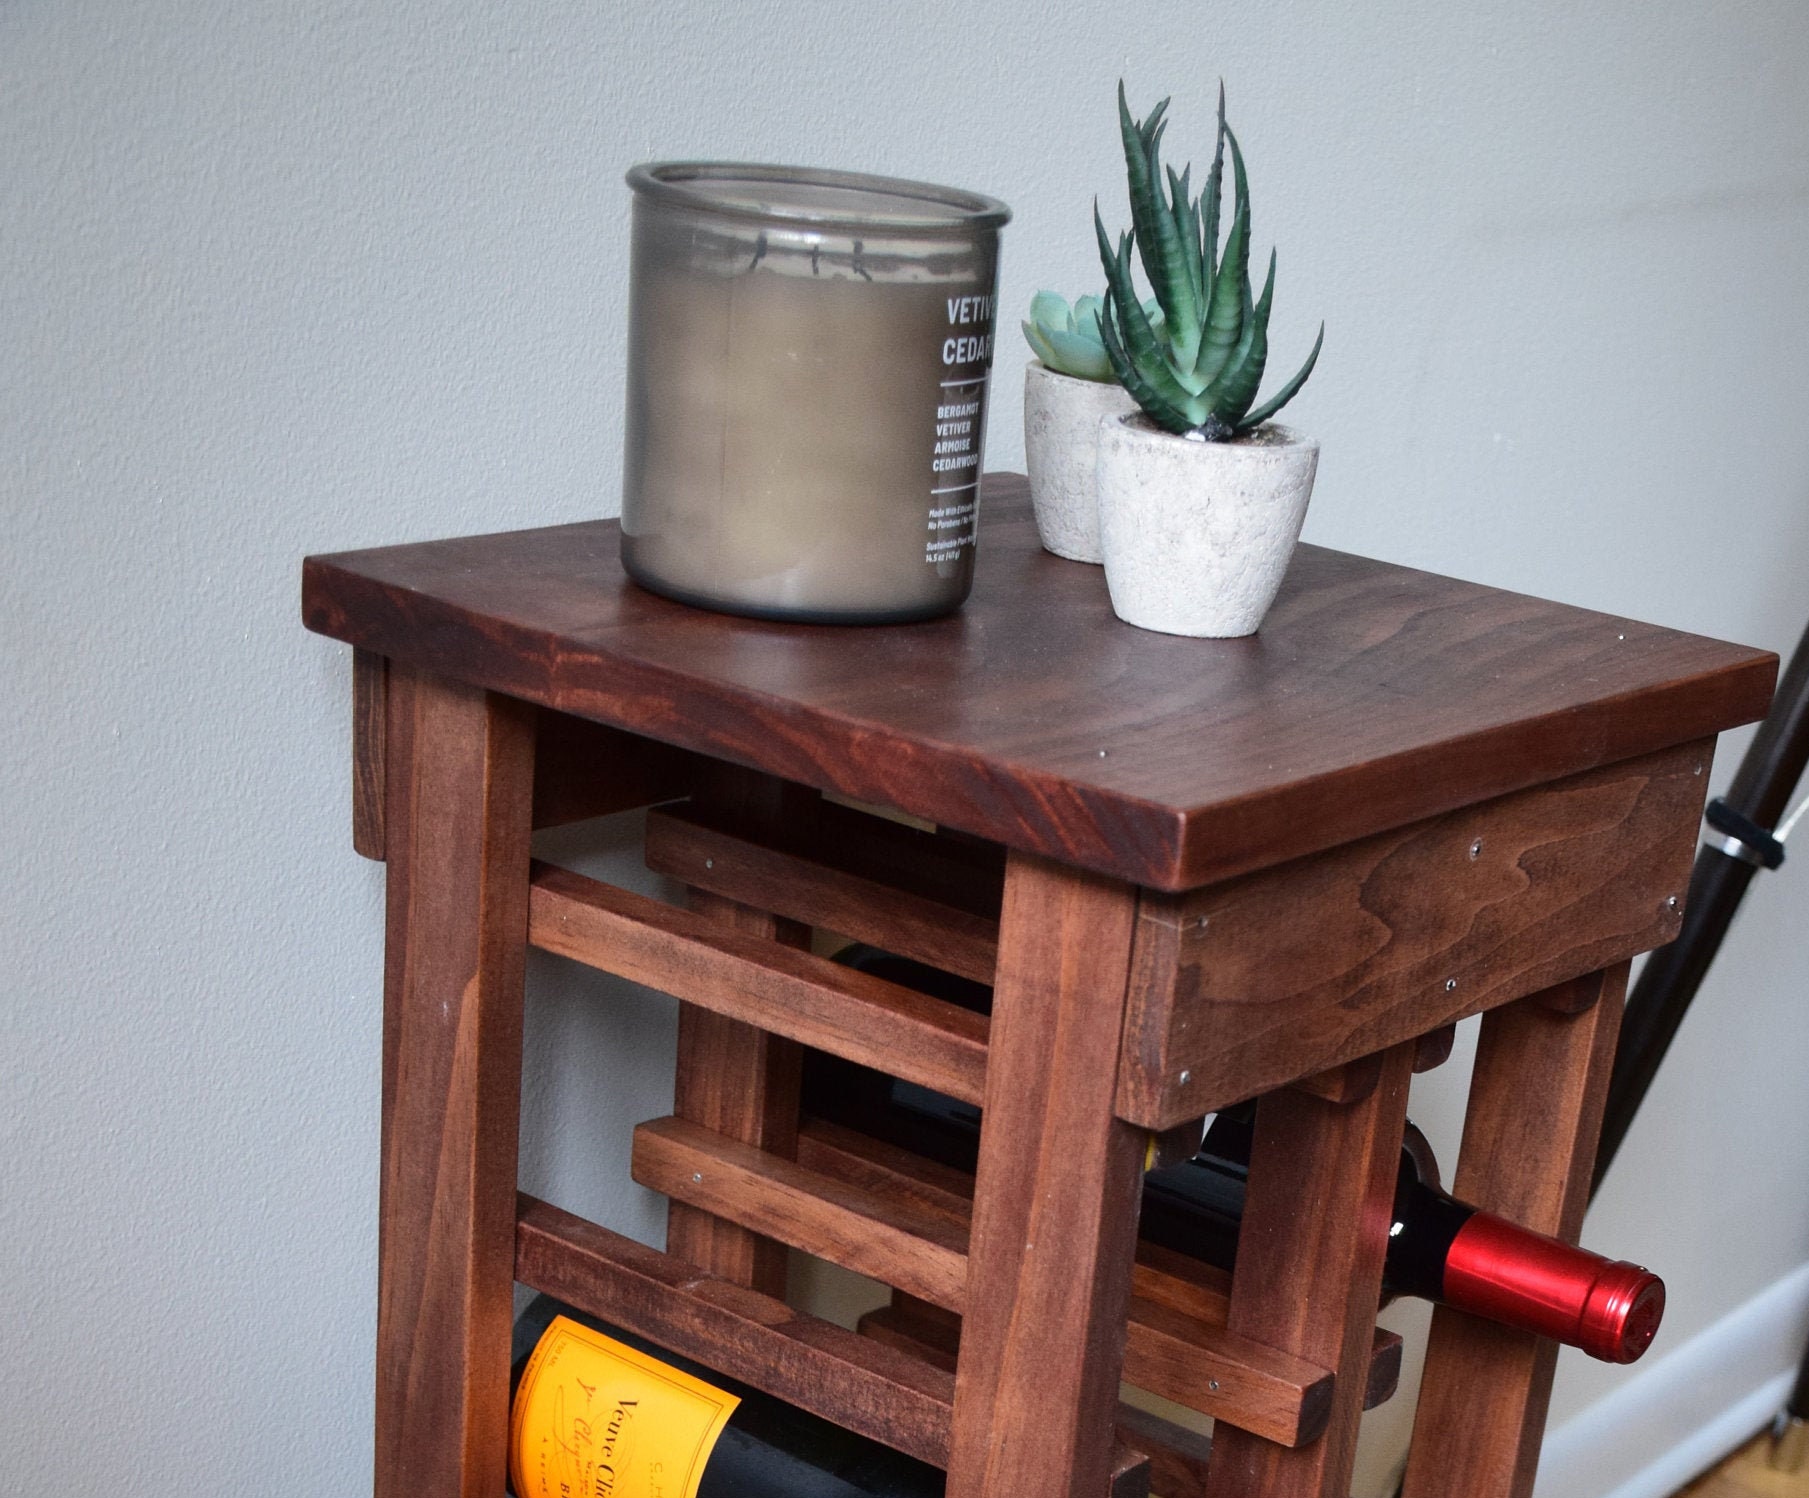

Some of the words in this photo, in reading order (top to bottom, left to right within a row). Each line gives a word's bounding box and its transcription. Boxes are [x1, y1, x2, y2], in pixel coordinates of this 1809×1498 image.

[937, 402, 979, 419] BERGAMOT
[936, 421, 971, 437] VETIVER
[934, 438, 971, 455] ARMOISE
[932, 454, 978, 472] CEDARWOOD
[601, 1399, 639, 1458] Veuve
